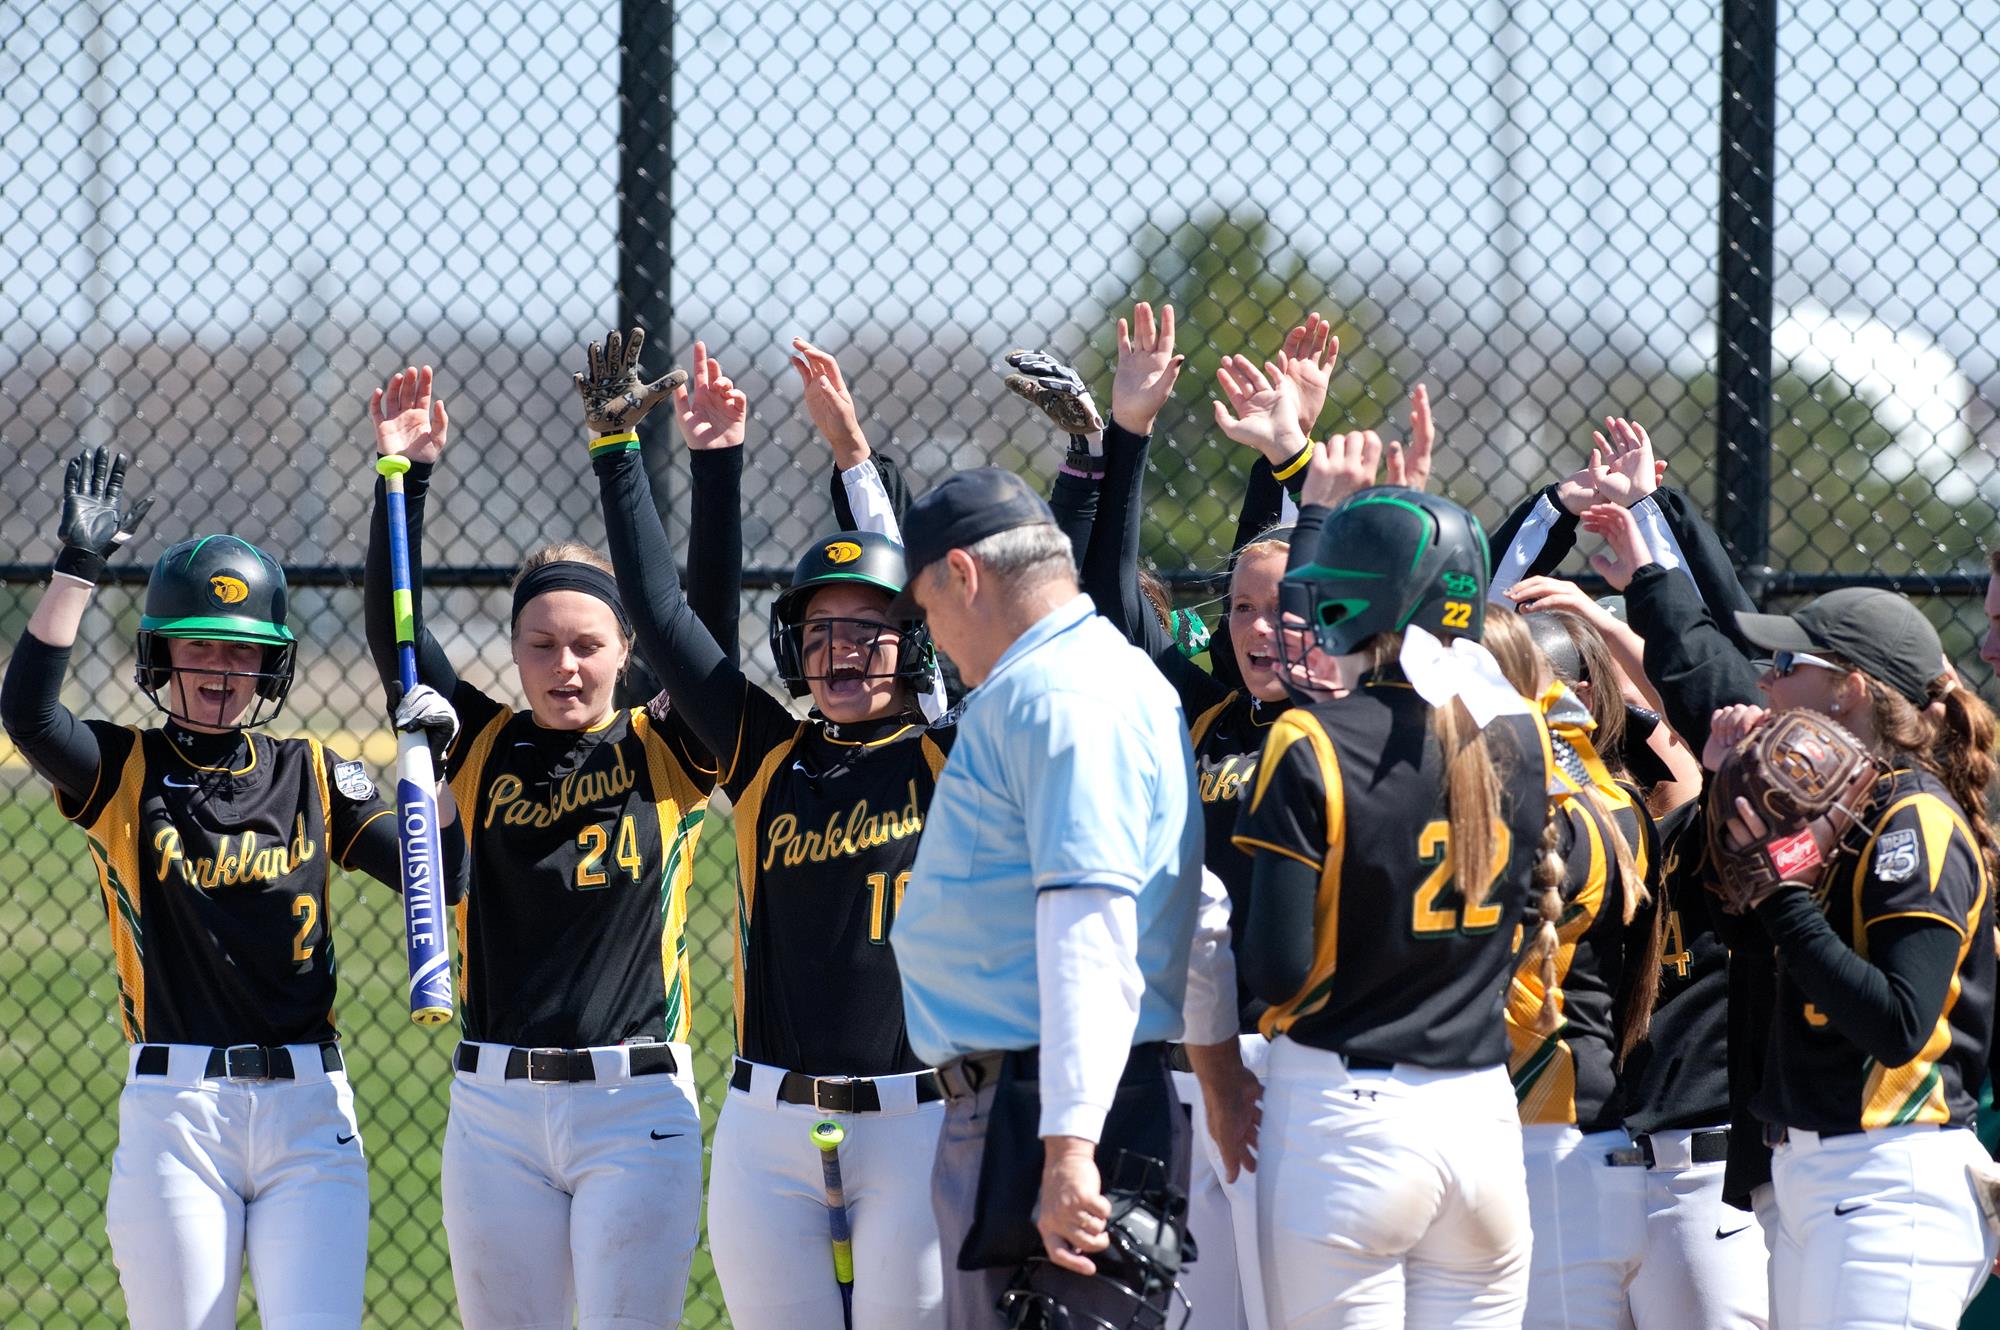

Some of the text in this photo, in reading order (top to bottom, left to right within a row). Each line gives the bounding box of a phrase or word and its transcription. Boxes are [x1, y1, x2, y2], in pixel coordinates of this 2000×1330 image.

[1442, 601, 1472, 628] 22
[484, 743, 635, 829] Parkland
[763, 778, 924, 871] Parkland
[154, 811, 316, 889] Parkland
[404, 801, 433, 949] LOUISVILLE
[575, 814, 643, 891] 24
[291, 892, 318, 962] 2
